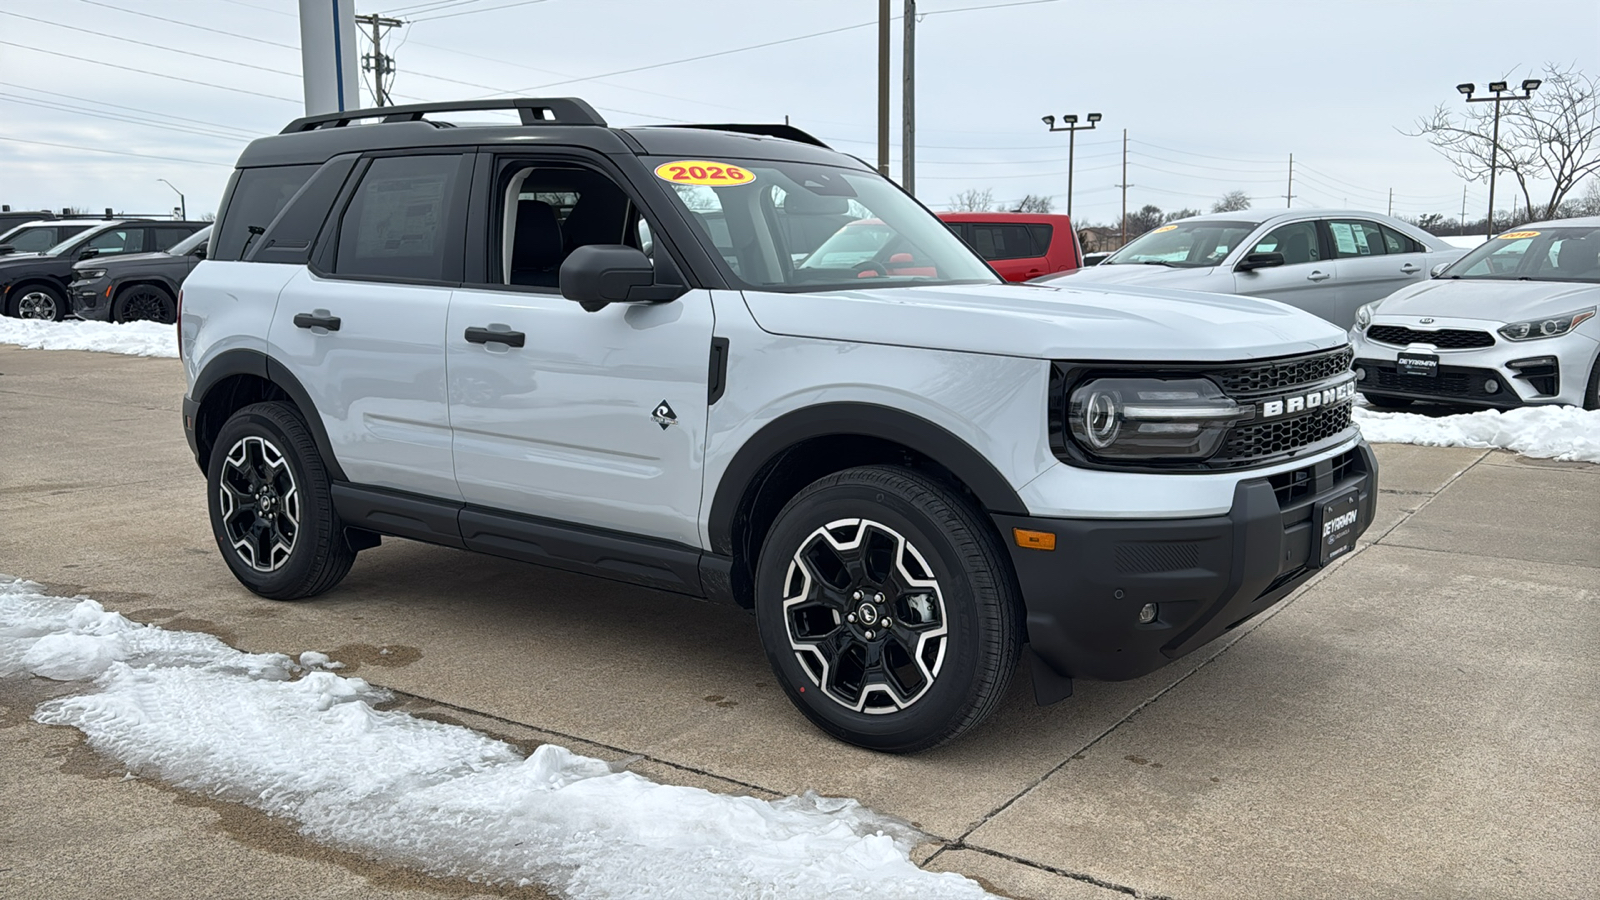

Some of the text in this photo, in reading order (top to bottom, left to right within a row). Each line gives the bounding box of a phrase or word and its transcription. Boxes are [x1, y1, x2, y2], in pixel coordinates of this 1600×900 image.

[668, 166, 745, 180] 2026
[1263, 381, 1354, 417] BRONCO
[1323, 509, 1358, 538] DEYARMAN
